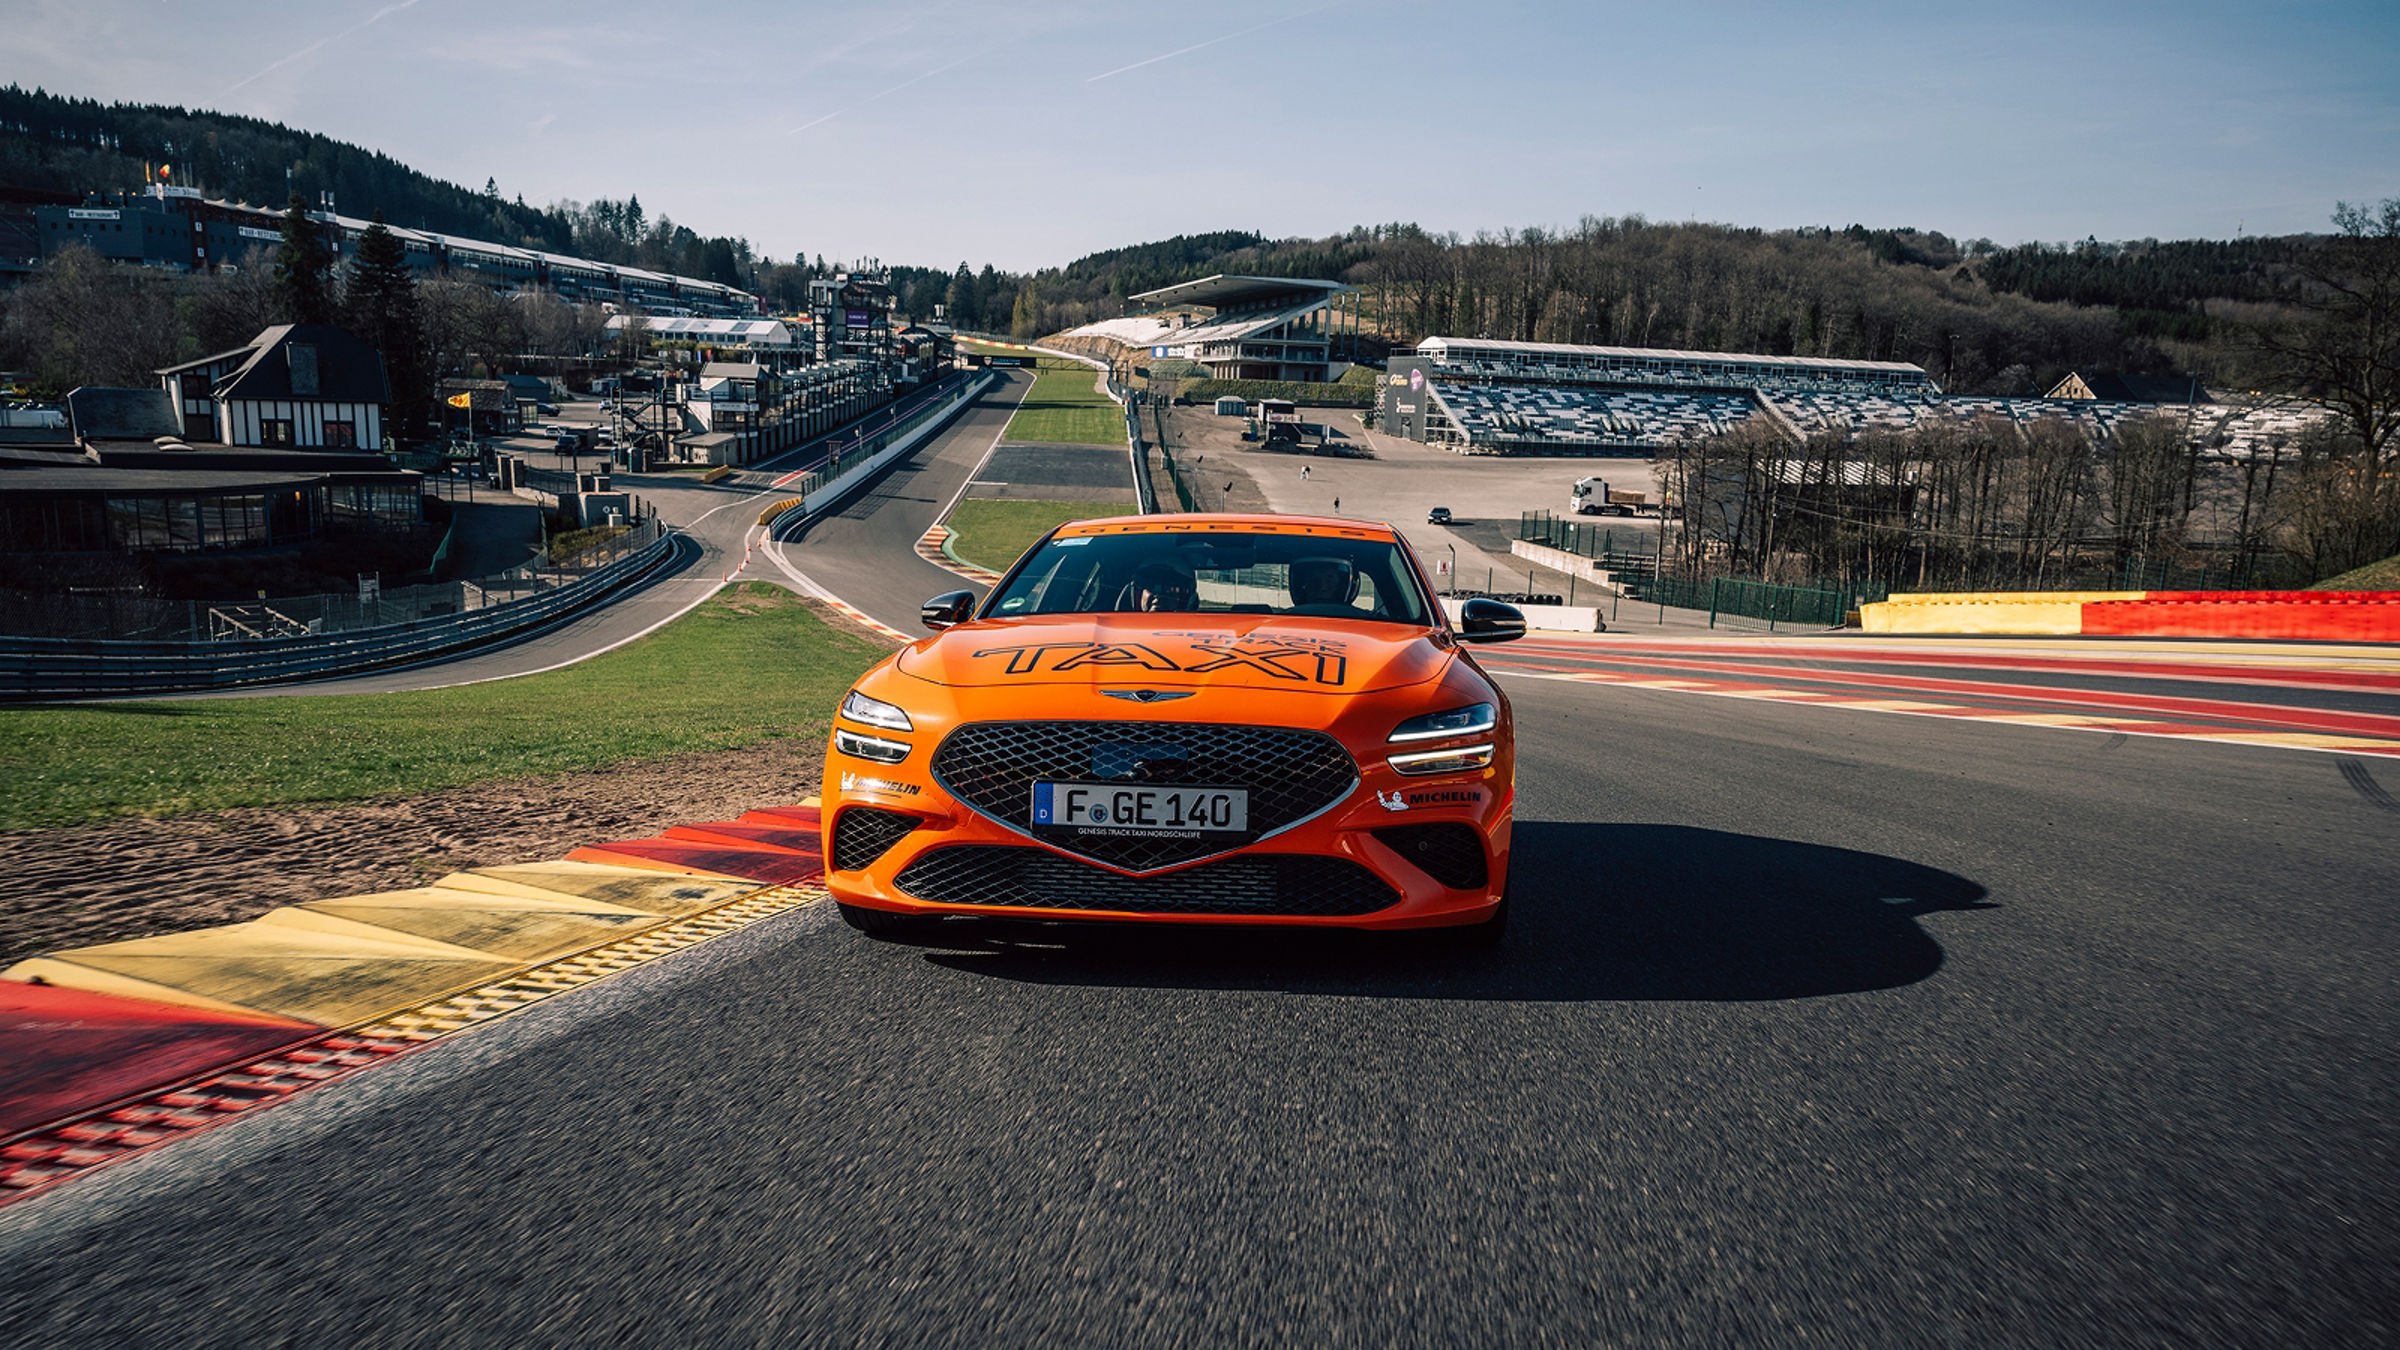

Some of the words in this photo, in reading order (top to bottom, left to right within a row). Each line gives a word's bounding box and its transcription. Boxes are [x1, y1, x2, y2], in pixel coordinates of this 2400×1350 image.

[972, 642, 1347, 686] TAXI
[1409, 792, 1482, 805] MICHELIN
[1039, 808, 1048, 819] D
[1066, 790, 1088, 822] F
[1112, 791, 1158, 826] GE
[1165, 793, 1231, 827] 140
[1078, 827, 1107, 836] GENESIS
[1108, 829, 1131, 837] TRACK
[1132, 829, 1147, 837] TAXI
[1147, 830, 1201, 839] NORDSCHLEIFE
